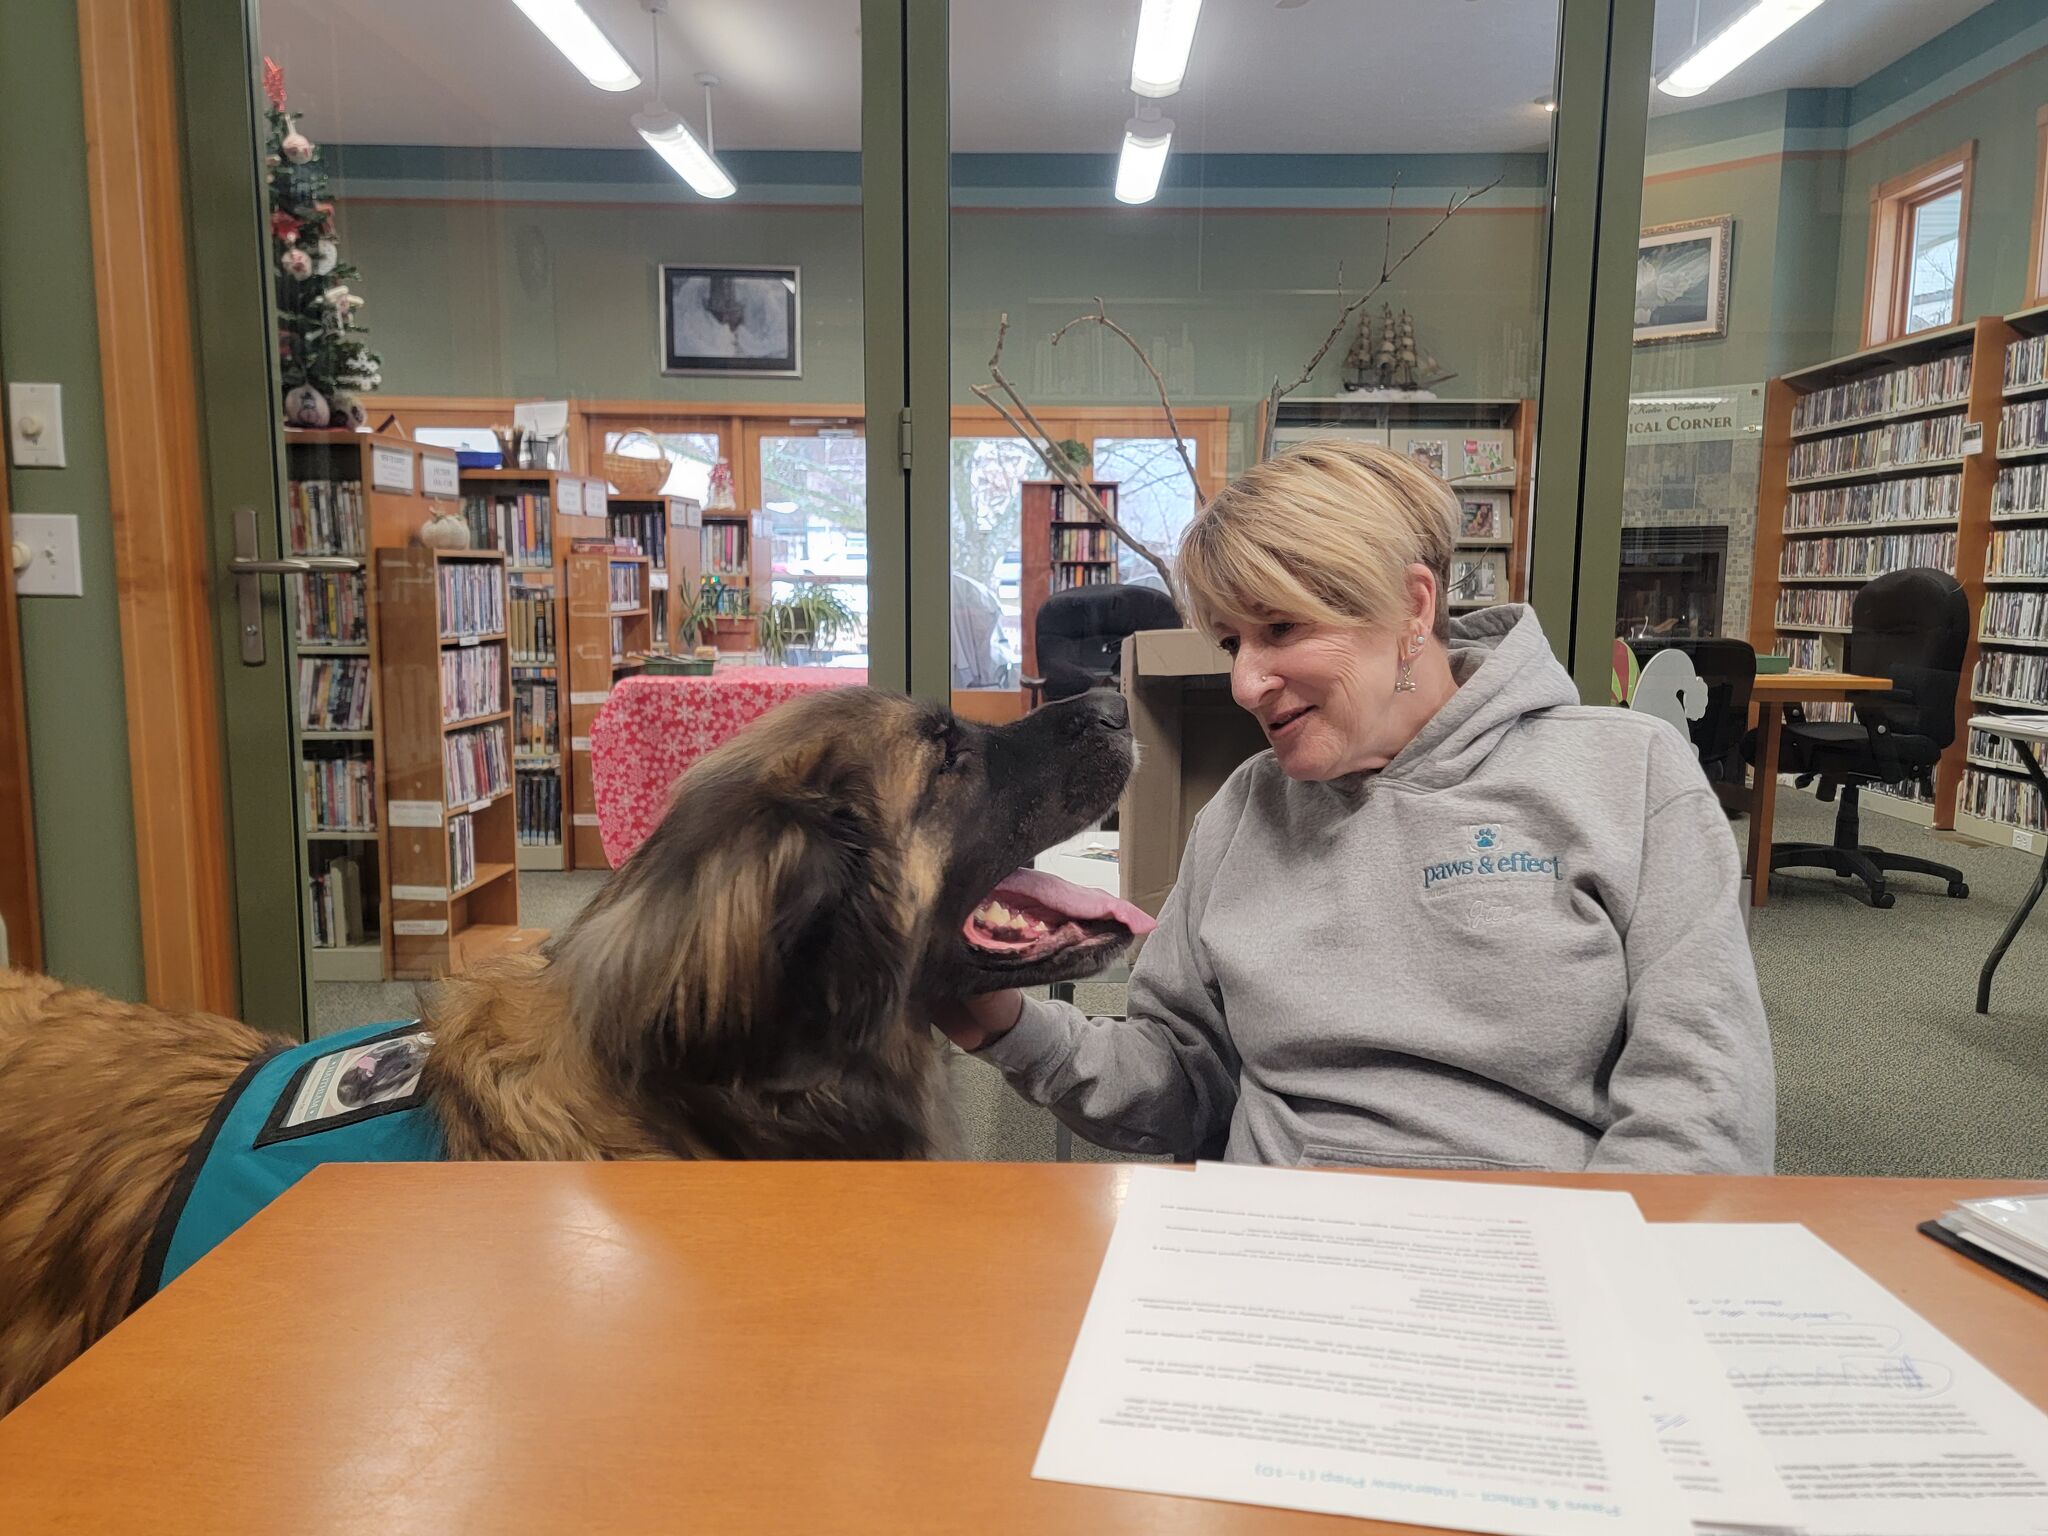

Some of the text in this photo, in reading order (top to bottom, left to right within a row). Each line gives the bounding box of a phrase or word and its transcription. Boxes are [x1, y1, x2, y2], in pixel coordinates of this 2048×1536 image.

[1666, 416, 1732, 431] CORNER
[1423, 851, 1563, 888] paws & effect
